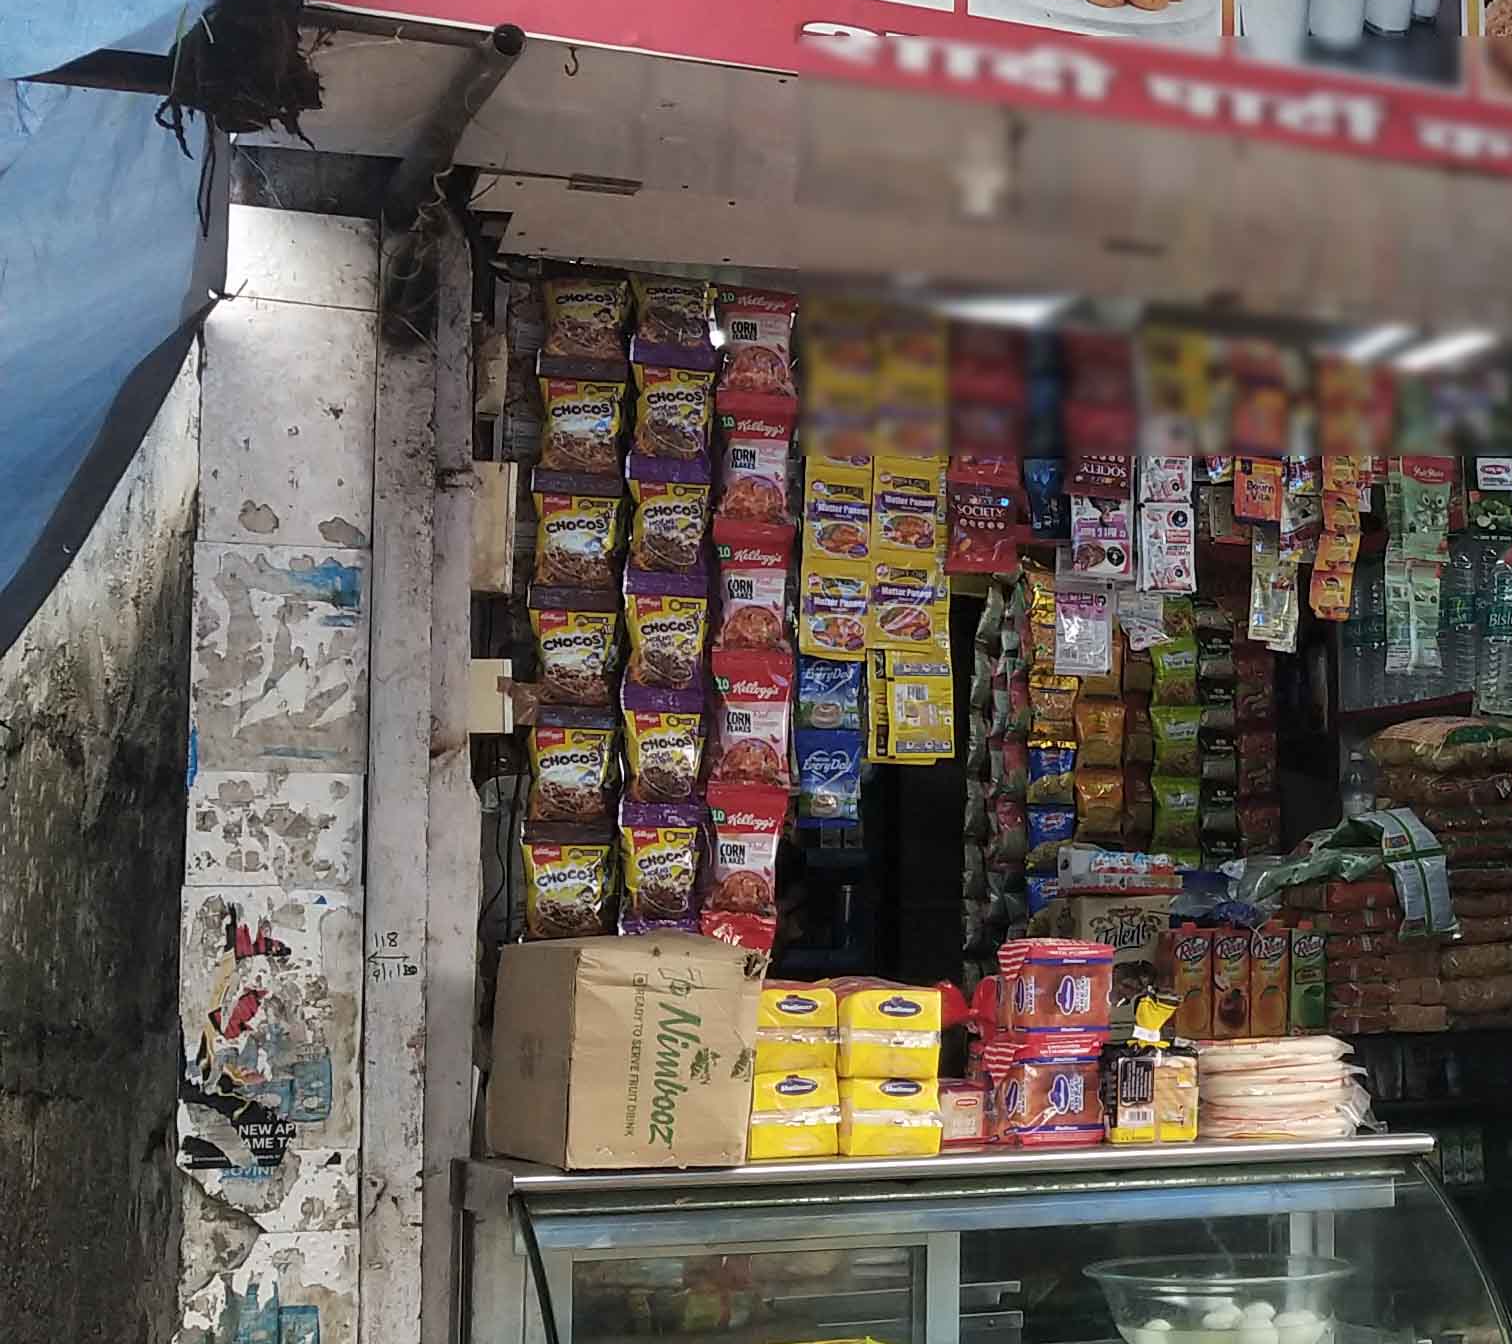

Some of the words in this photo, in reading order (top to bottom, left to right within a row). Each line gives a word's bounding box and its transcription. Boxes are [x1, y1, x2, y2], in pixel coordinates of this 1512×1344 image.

[557, 291, 614, 306] CHOCOS
[731, 321, 758, 333] CORN
[646, 390, 704, 405] CHOCOS
[551, 403, 611, 418] CHOCOS
[738, 419, 786, 436] Kellogg's
[732, 448, 757, 461] CORN
[1080, 462, 1127, 478] SOCIETY
[643, 504, 701, 519] CHOCOS
[957, 505, 1005, 519] SOCIETY
[545, 518, 605, 535] CHOCOS
[734, 548, 783, 565] Kellogg's
[728, 578, 754, 592] CORN
[640, 620, 695, 636] CHOCOS
[542, 635, 601, 652] CHOCOS
[731, 681, 780, 697] Kellogg's
[726, 711, 752, 725] CORN
[640, 737, 692, 752] CHOCOS
[539, 752, 599, 769] CHOCOS
[726, 813, 776, 830] Kellogg's
[720, 843, 746, 858] CORN
[374, 931, 399, 948] 118
[632, 1023, 643, 1038] TO
[629, 1039, 642, 1073] SERVE
[648, 1001, 702, 1150] Nimbooz
[626, 1073, 640, 1103] FRUIT
[624, 1103, 638, 1137] DRINK
[239, 1123, 272, 1136] NEW
